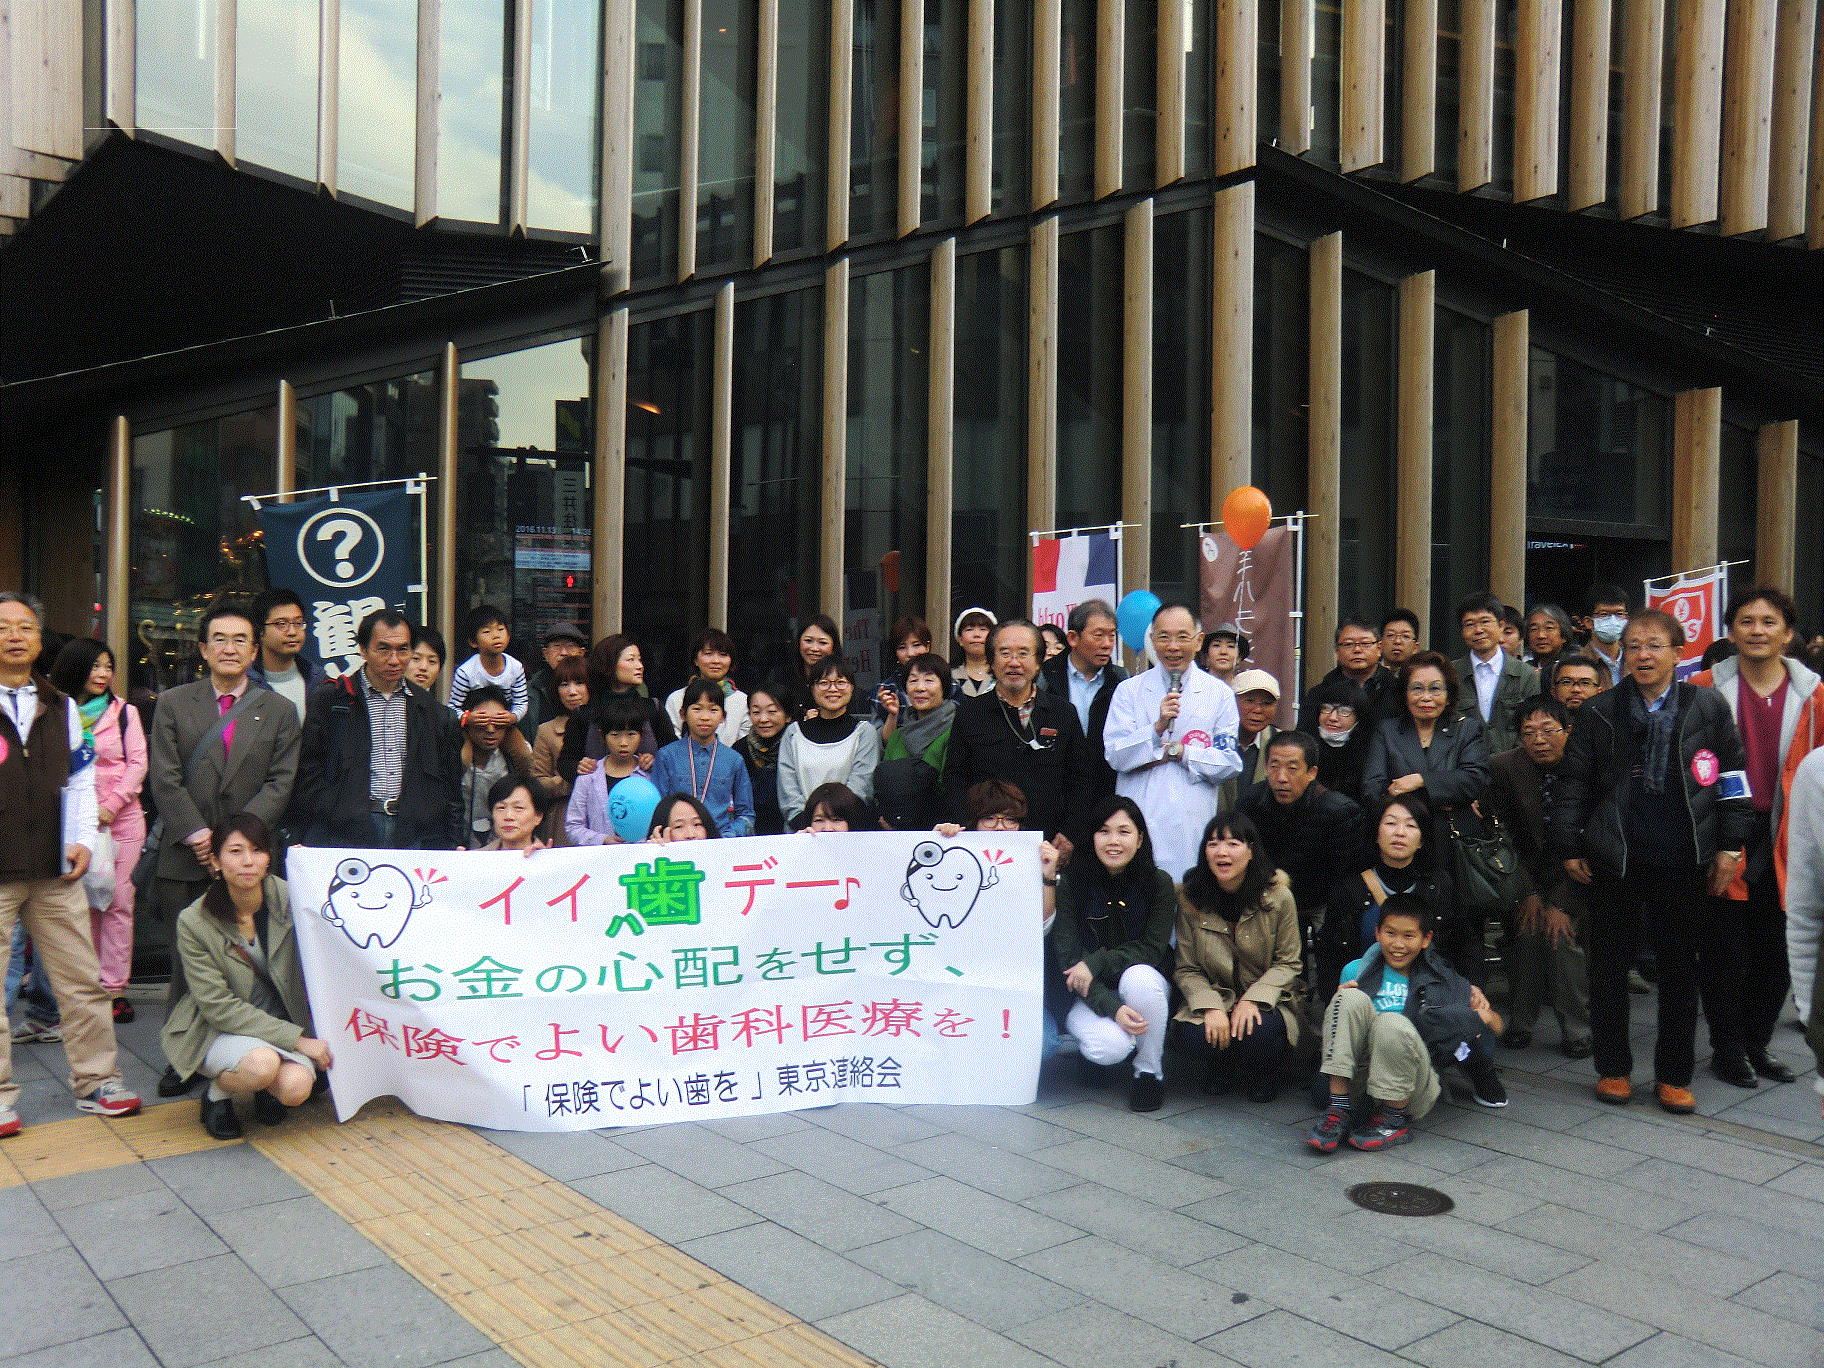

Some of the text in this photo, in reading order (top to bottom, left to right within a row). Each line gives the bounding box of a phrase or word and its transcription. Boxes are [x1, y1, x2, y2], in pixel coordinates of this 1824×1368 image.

[375, 932, 965, 1002] お金の心配をせず、
